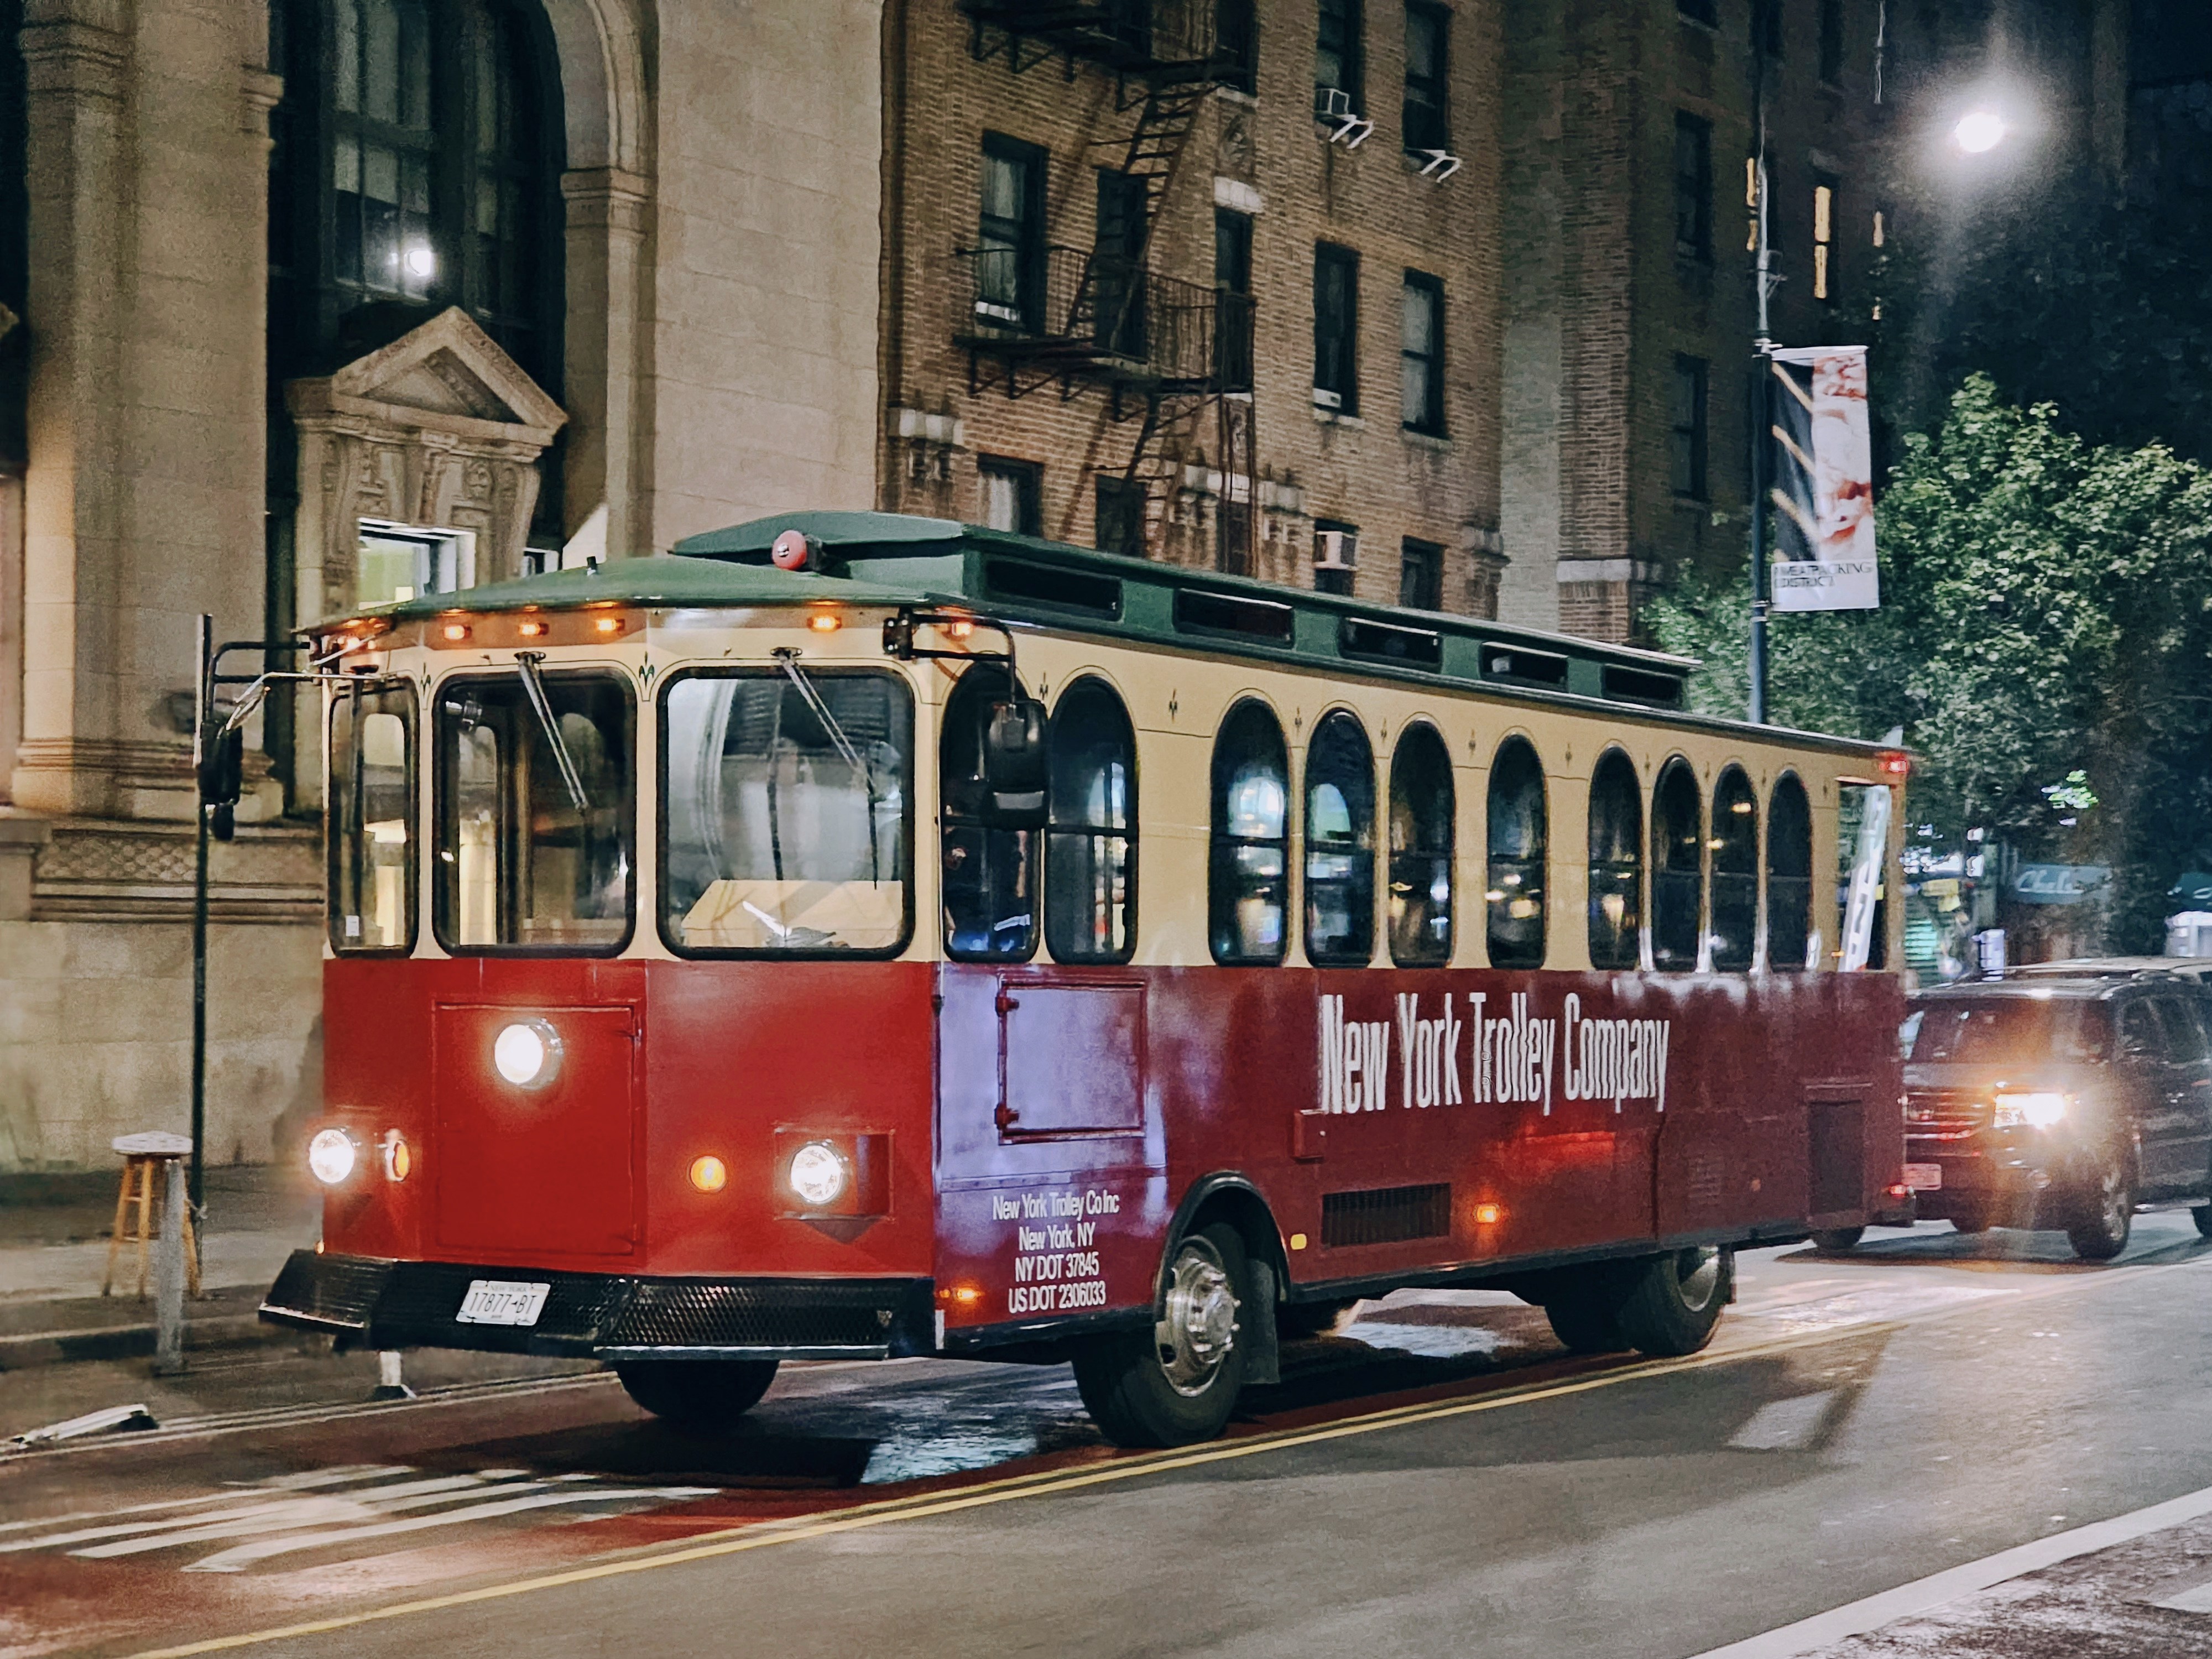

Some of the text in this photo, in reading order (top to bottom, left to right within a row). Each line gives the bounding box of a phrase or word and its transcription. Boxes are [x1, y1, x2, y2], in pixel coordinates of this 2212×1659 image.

[1321, 992, 1670, 1115] New York Trolley Company
[993, 1189, 1120, 1221] New York Trolley Co Inc
[1019, 1226, 1045, 1251] New
[1077, 1222, 1095, 1246] NY
[1015, 1251, 1099, 1282] NY DOT 37845
[1008, 1280, 1105, 1313] US DOT 2306033
